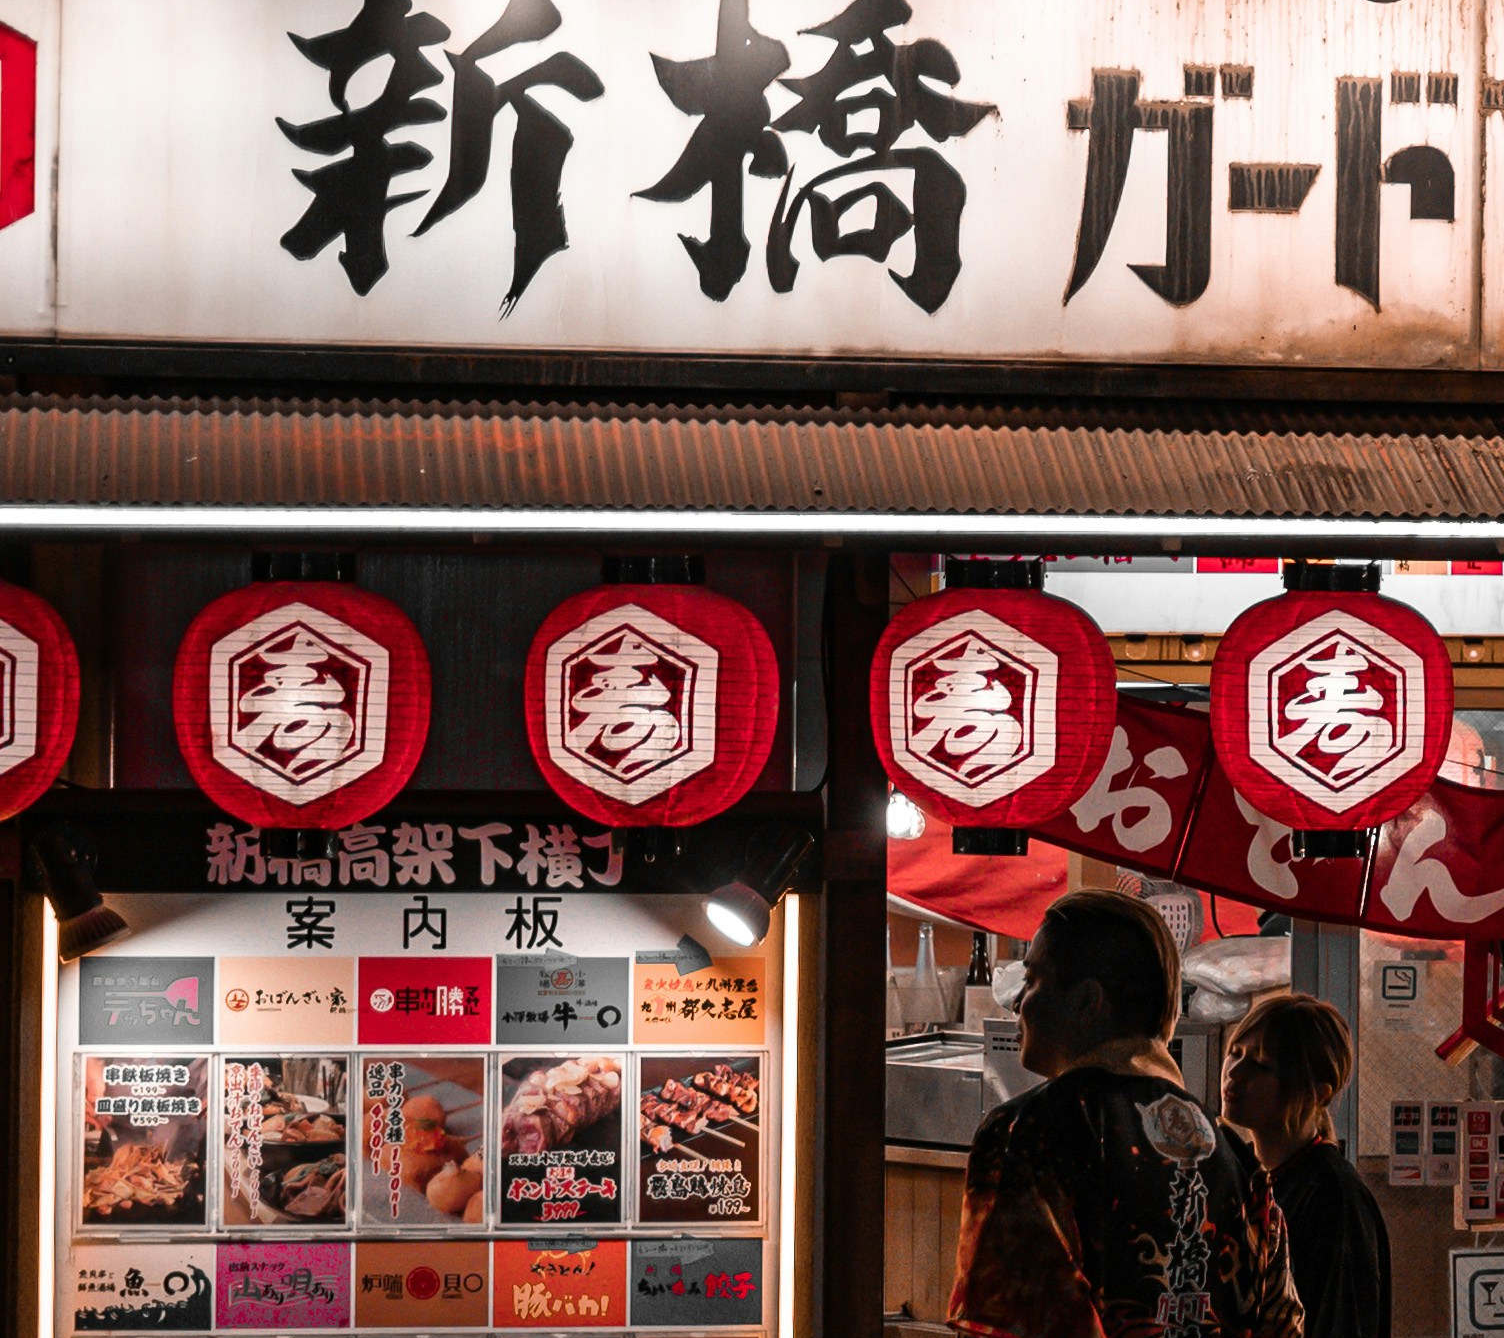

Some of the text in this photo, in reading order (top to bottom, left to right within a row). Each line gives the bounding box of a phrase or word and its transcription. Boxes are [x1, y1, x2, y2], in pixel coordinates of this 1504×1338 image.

[285, 895, 564, 950] 案内板
[255, 987, 348, 1007] おばんざい家
[104, 1065, 190, 1084] 串鉄板焼き
[96, 1098, 201, 1114] 皿盛り鉄板焼き
[513, 1282, 610, 1318] 豚バカ!
